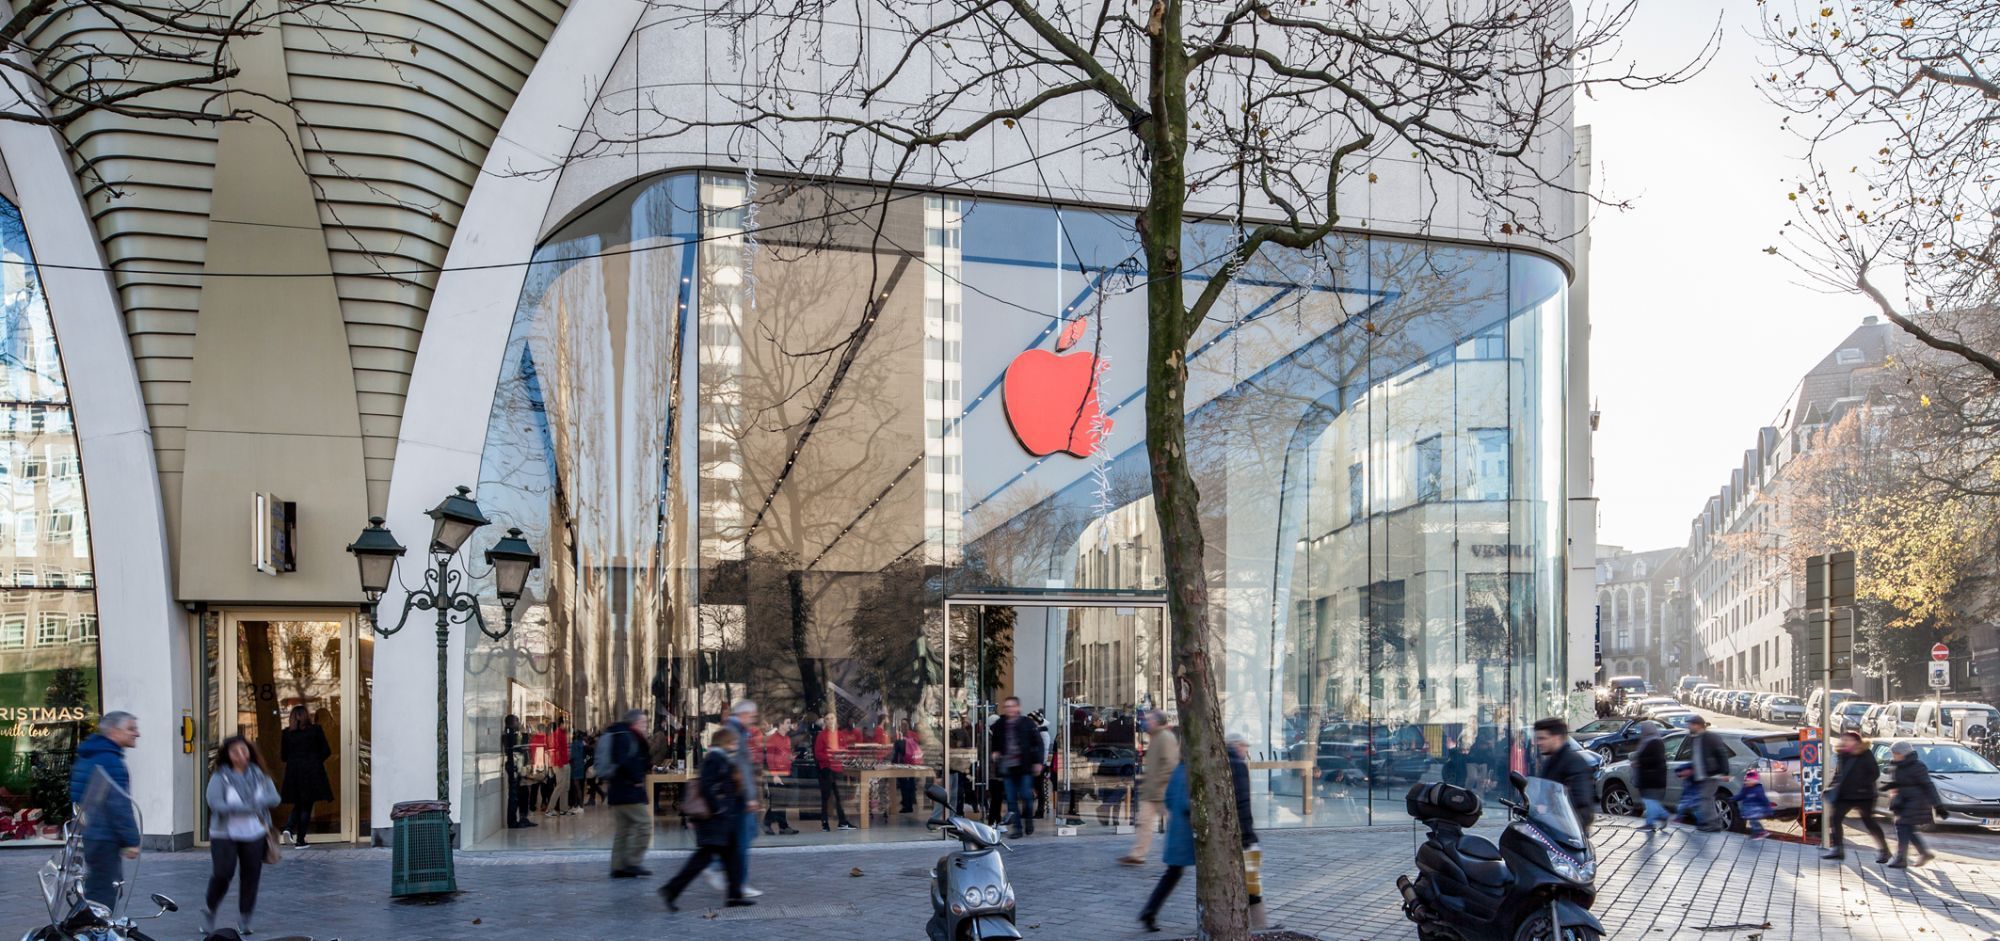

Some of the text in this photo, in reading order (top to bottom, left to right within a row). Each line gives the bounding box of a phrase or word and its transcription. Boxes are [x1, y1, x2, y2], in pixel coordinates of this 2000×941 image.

[246, 683, 273, 701] 28
[0, 723, 51, 737] with love
